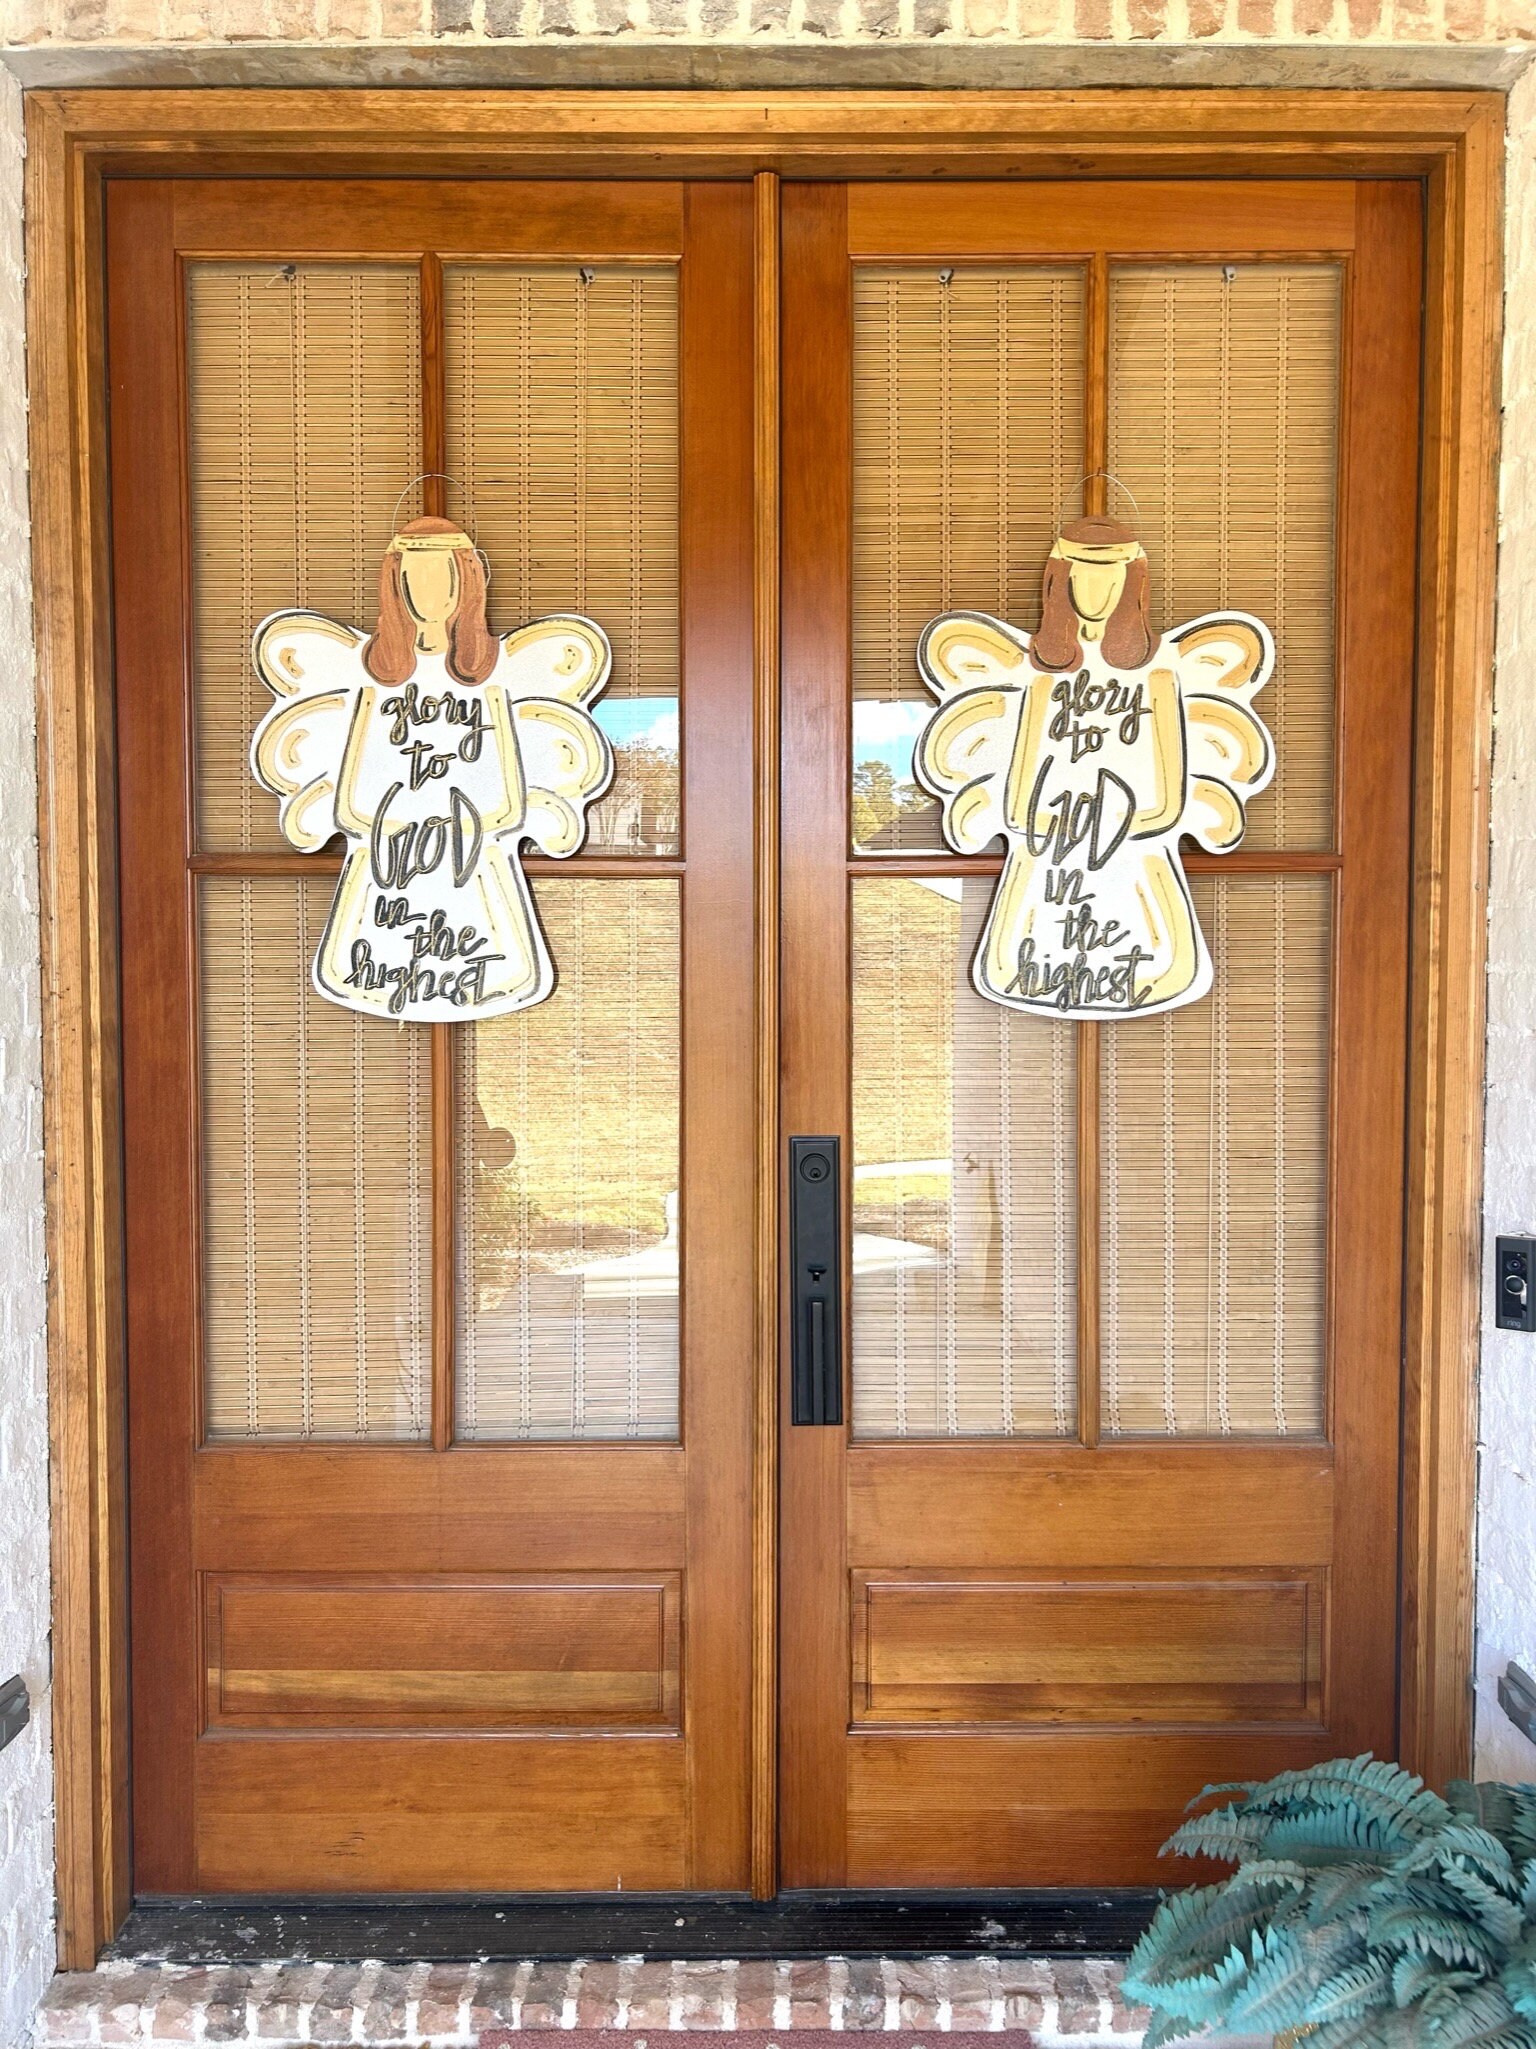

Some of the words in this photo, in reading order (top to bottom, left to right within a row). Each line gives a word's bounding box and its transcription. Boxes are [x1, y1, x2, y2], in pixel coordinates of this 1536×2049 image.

[381, 683, 495, 762] glory
[1049, 669, 1153, 745] glory
[400, 740, 457, 791] to
[1066, 721, 1110, 764] to
[375, 895, 427, 929] in
[1045, 868, 1095, 905] in
[404, 909, 488, 961] the
[1054, 903, 1131, 952] the
[1005, 937, 1154, 1012] highest
